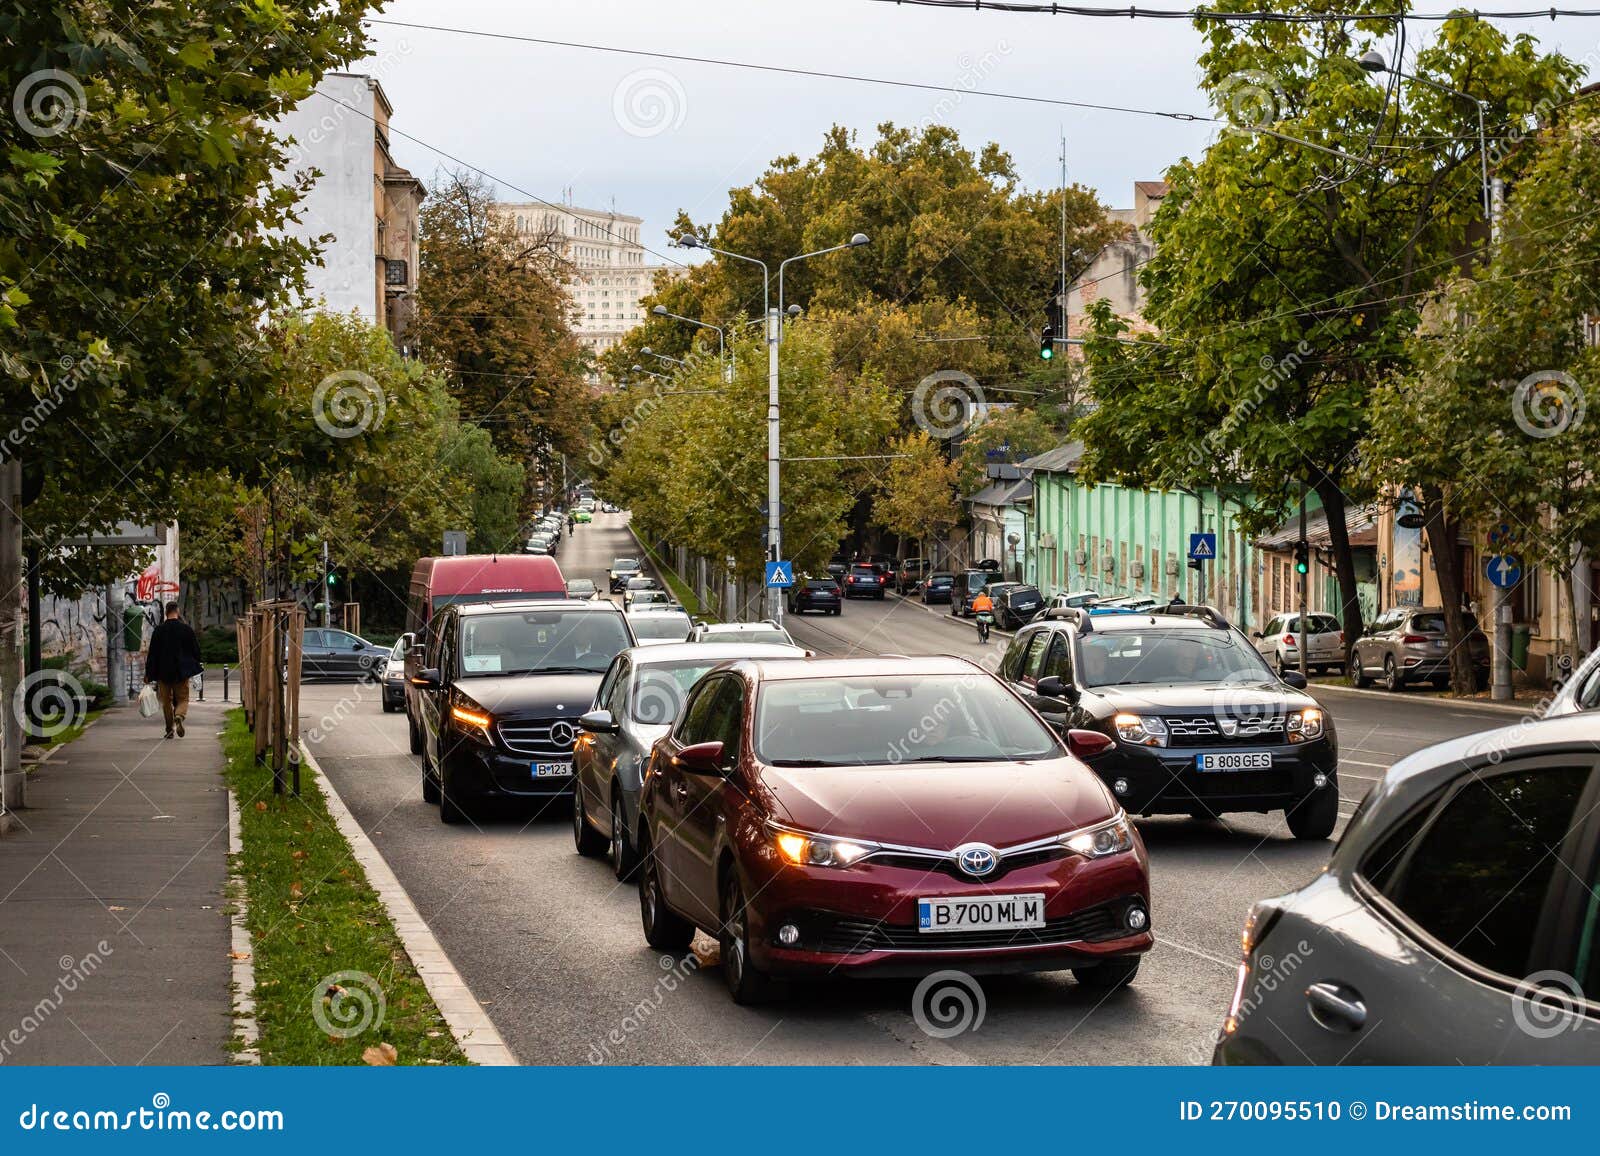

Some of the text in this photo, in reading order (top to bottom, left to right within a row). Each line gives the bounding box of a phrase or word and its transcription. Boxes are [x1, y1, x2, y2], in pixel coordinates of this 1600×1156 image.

[1205, 756, 1214, 768] B
[1218, 755, 1241, 768] 808
[1243, 754, 1270, 767] GES
[538, 764, 567, 776] B 123
[936, 901, 1038, 925] B 700 MLM
